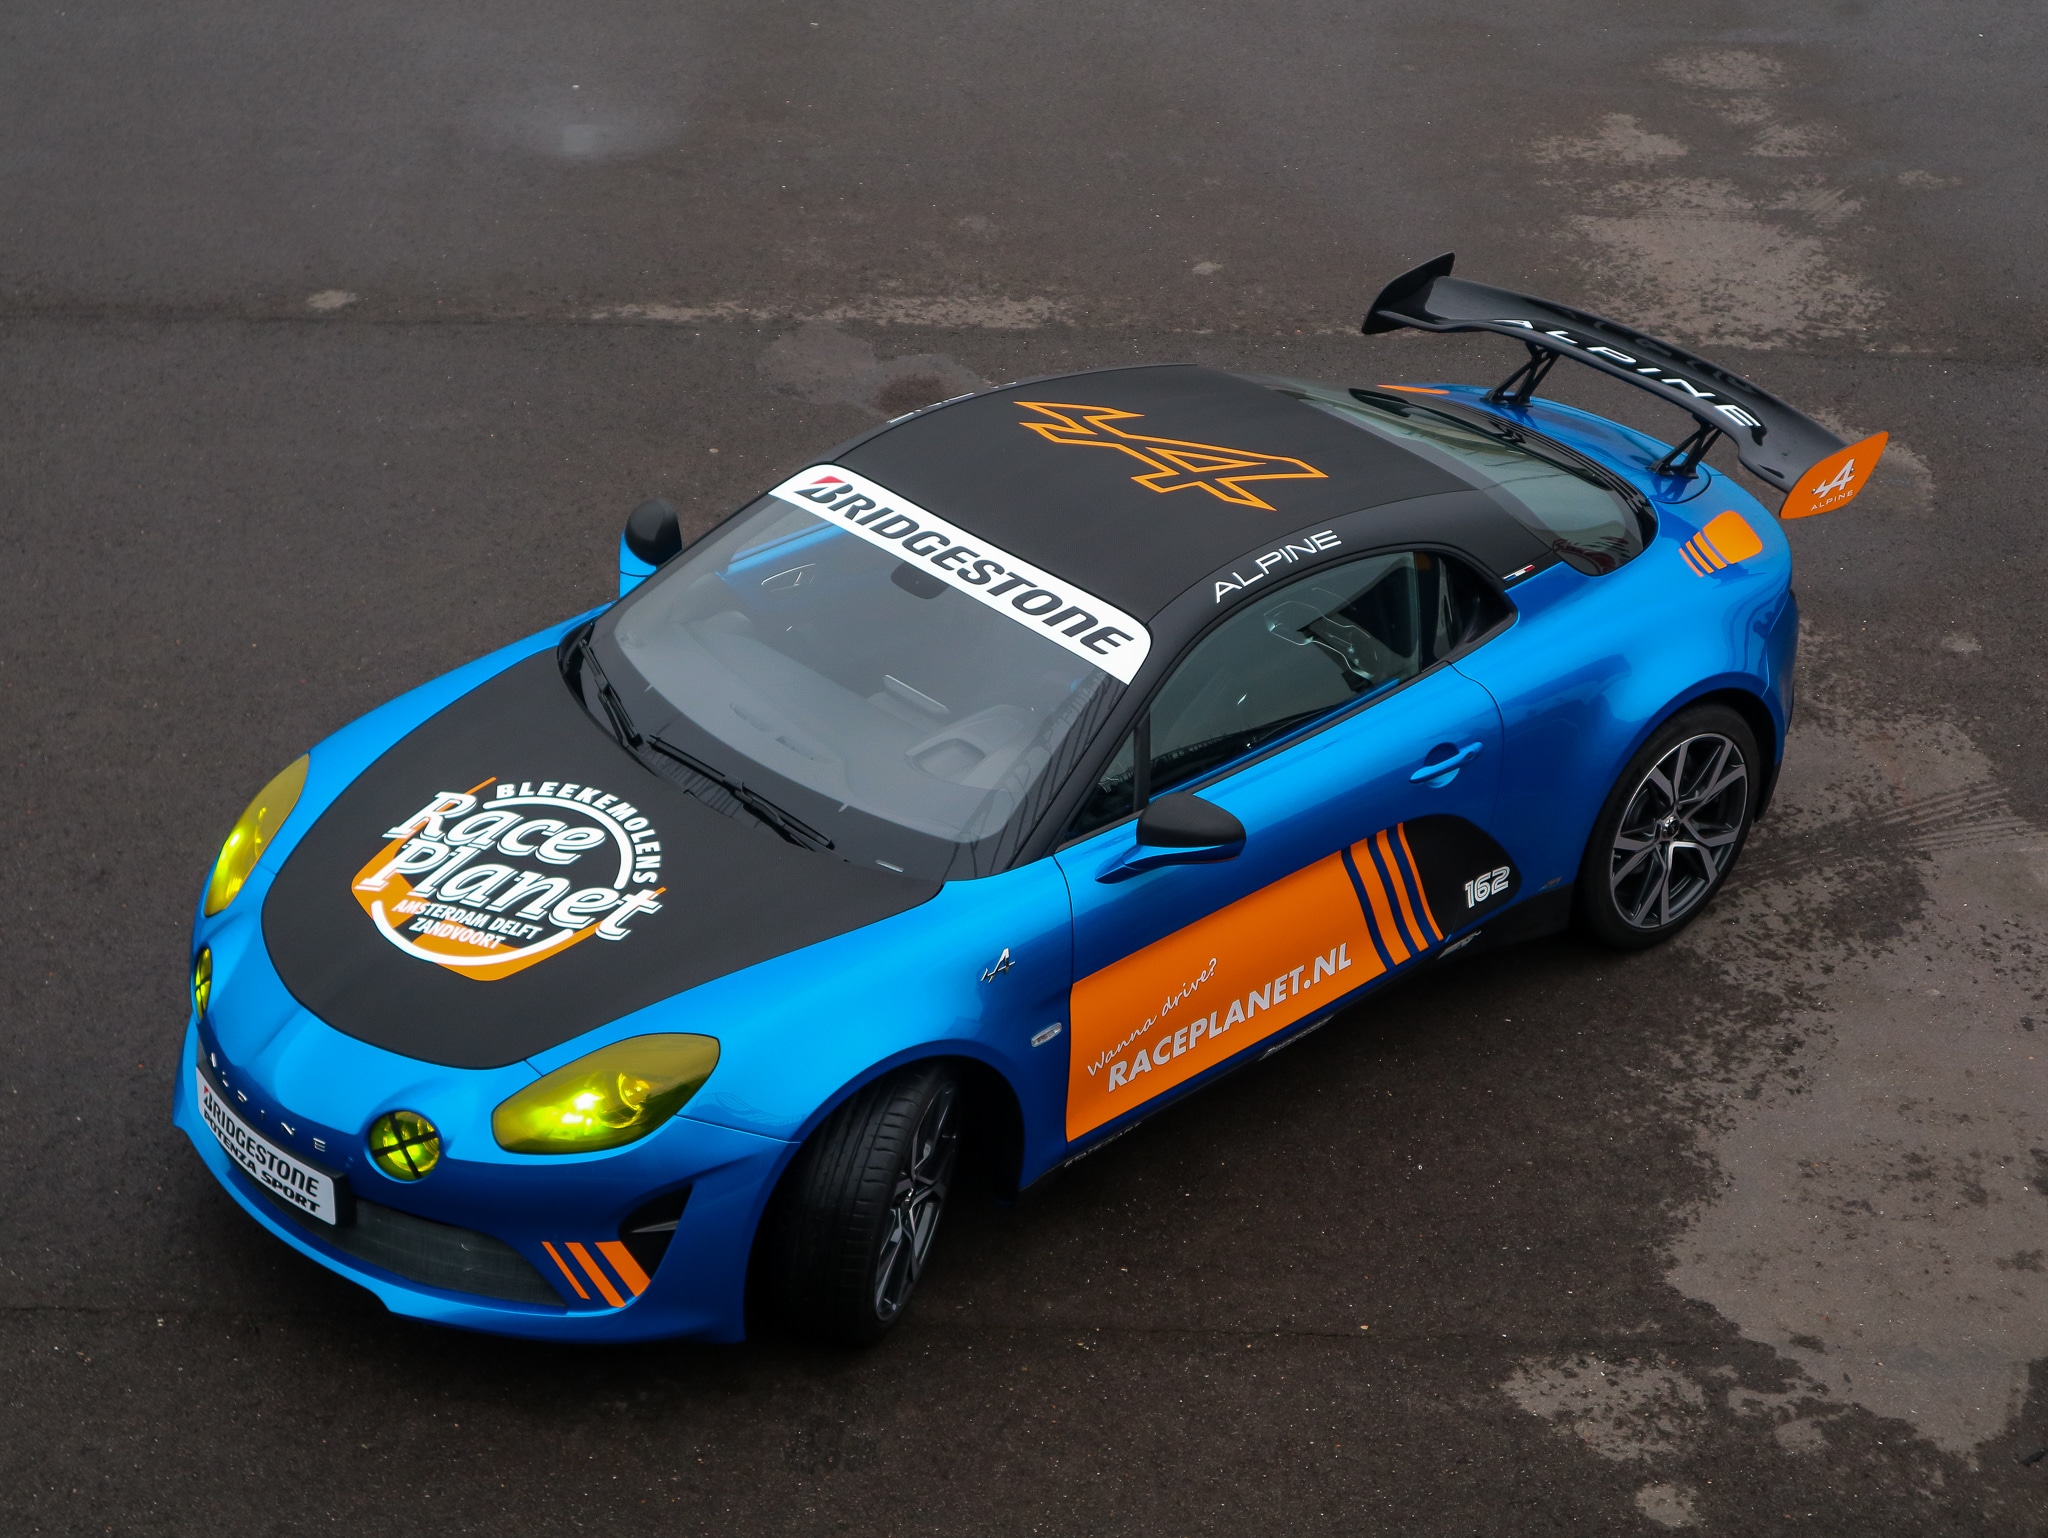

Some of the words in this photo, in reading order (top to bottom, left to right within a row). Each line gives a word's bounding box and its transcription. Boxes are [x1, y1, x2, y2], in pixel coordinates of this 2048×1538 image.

[1491, 319, 1761, 427] ALPINE
[1811, 489, 1854, 512] ALPINE
[794, 475, 1135, 656] BRIDGESTONE
[1213, 529, 1342, 604] ALPINE
[382, 791, 606, 866] Race
[496, 781, 662, 884] BLEEKEMOLENS
[354, 838, 663, 941] Planet
[391, 899, 490, 928] AMSTERDAM
[488, 917, 543, 940] DELFT
[408, 917, 506, 949] ZANDVOORT
[1464, 866, 1511, 909] 162
[1087, 1014, 1158, 1077] Wanna
[1161, 957, 1218, 1018] drive?
[1108, 942, 1352, 1092] RACEPLANET.NL
[203, 1085, 320, 1198] BRIDGESTONE
[203, 1109, 258, 1175] POTENZA
[260, 1170, 321, 1213] SPORT
